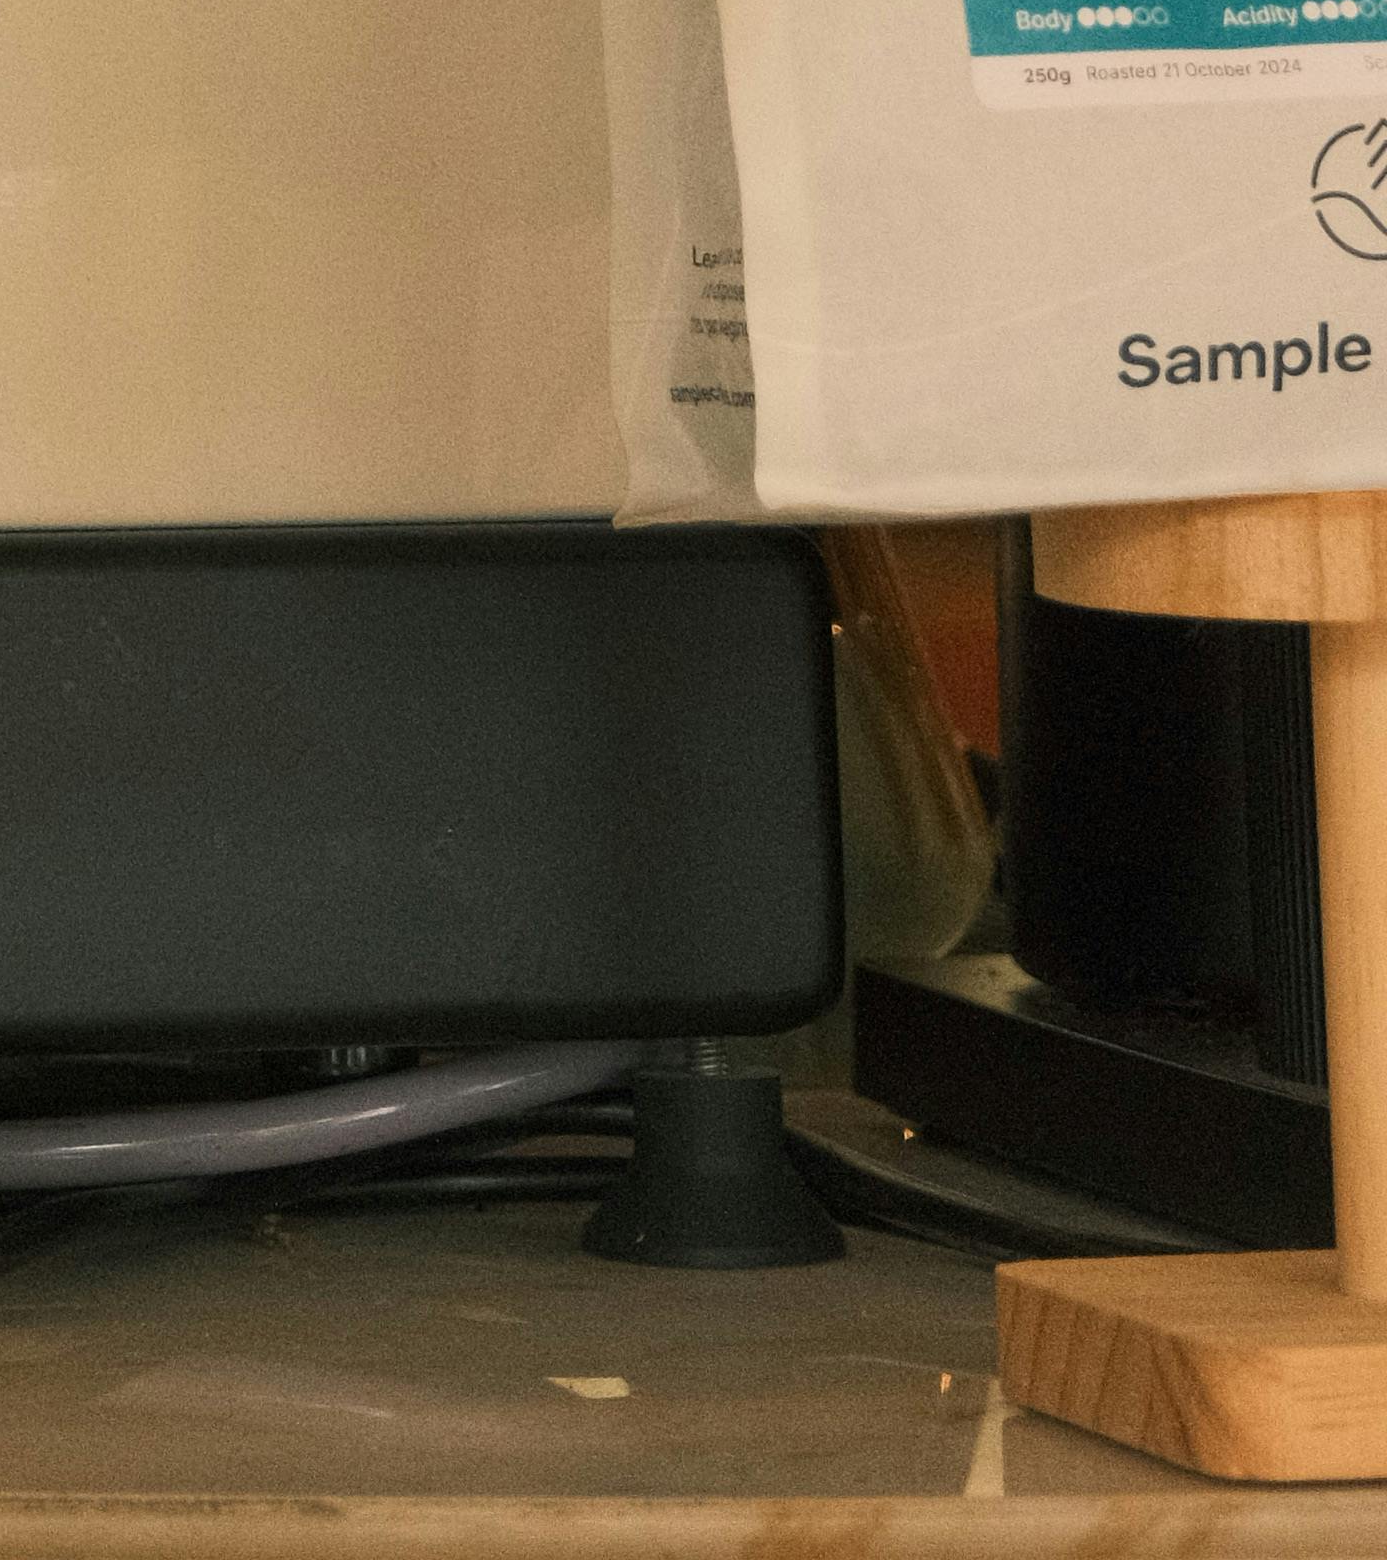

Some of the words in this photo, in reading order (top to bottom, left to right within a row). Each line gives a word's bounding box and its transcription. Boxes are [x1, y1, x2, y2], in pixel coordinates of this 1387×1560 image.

[1015, 9, 1073, 33] Body
[1223, 5, 1298, 27] Acidity
[1024, 68, 1071, 85] 250g
[1087, 64, 1156, 81] Roasted
[1163, 63, 1180, 79] 21
[1186, 61, 1251, 78] October
[1258, 59, 1302, 75] 2024
[1117, 320, 1373, 392] Sample
